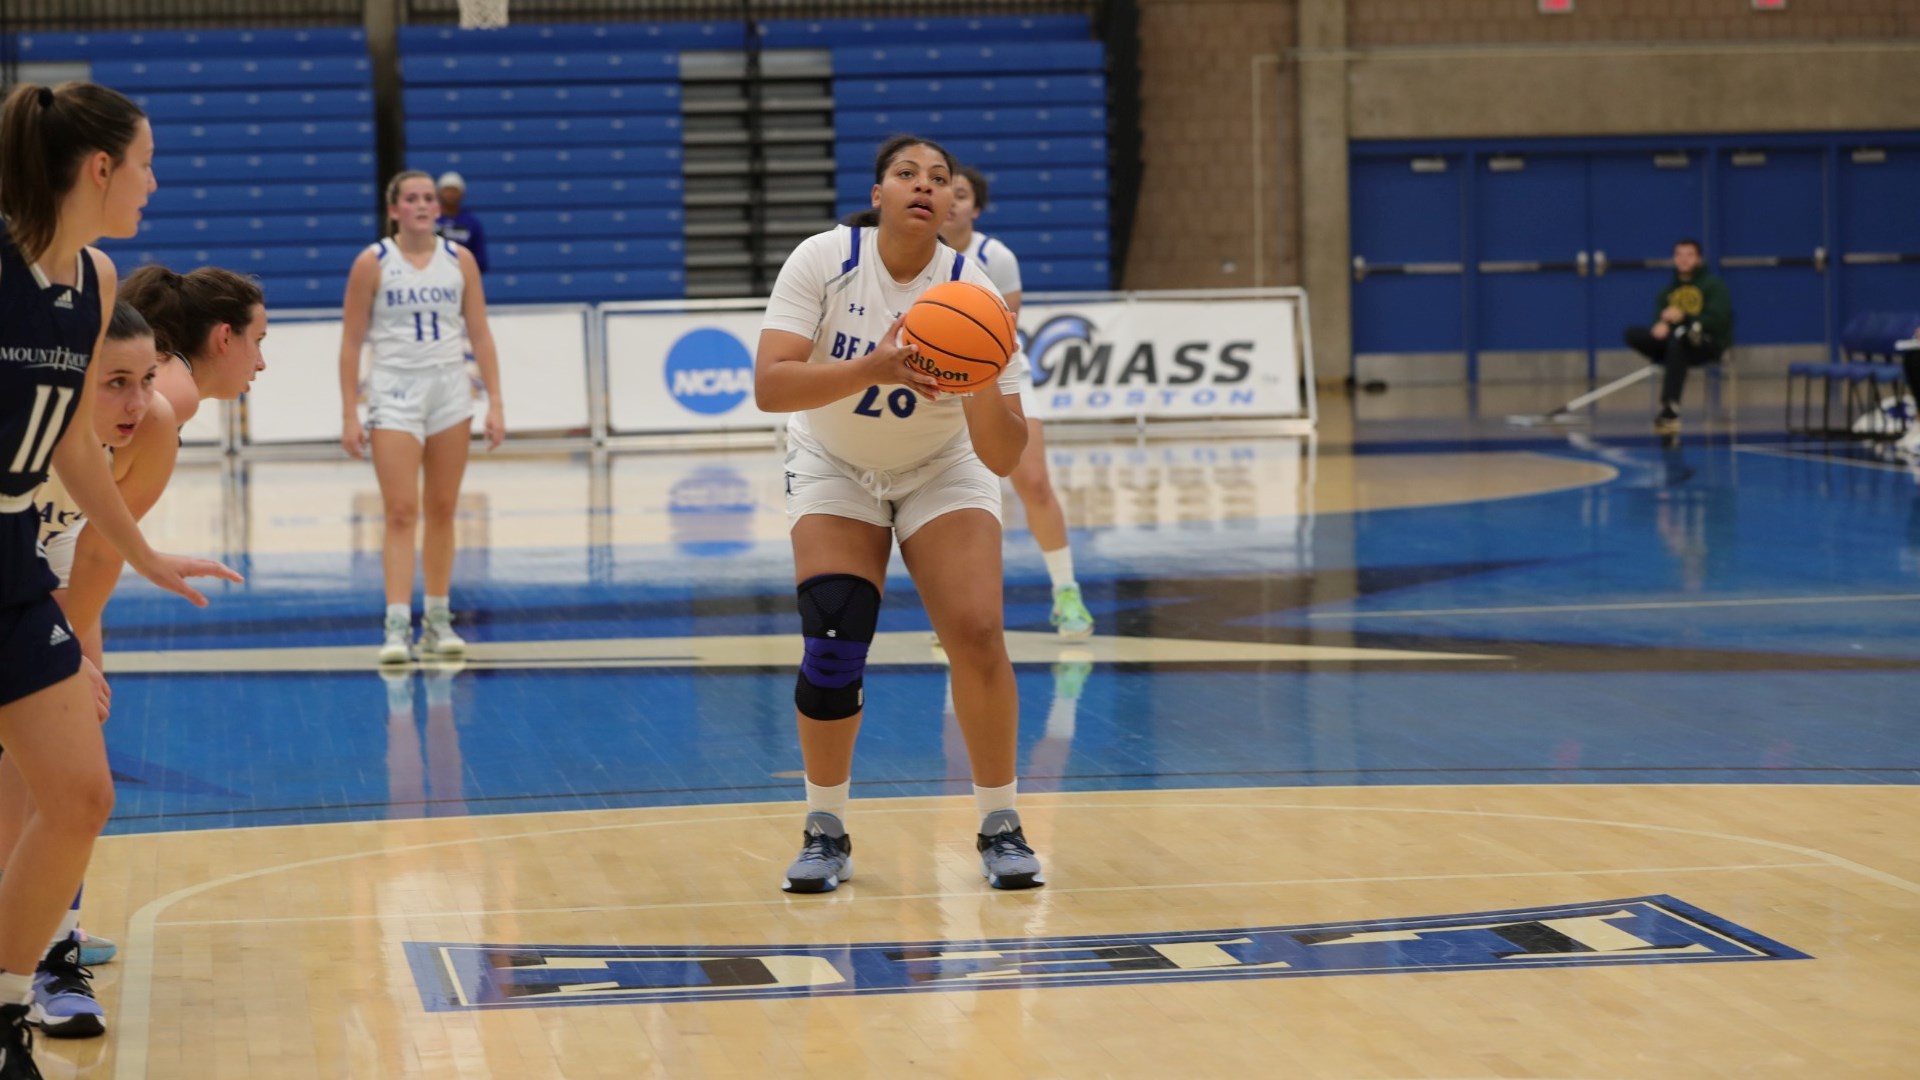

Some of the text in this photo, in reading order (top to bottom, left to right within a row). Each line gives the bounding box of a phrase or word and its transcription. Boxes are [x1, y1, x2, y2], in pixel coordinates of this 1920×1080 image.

[412, 311, 440, 341] 11
[673, 367, 754, 396] NCAA
[1051, 389, 1255, 408] BOSTON
[9, 384, 75, 473] 11
